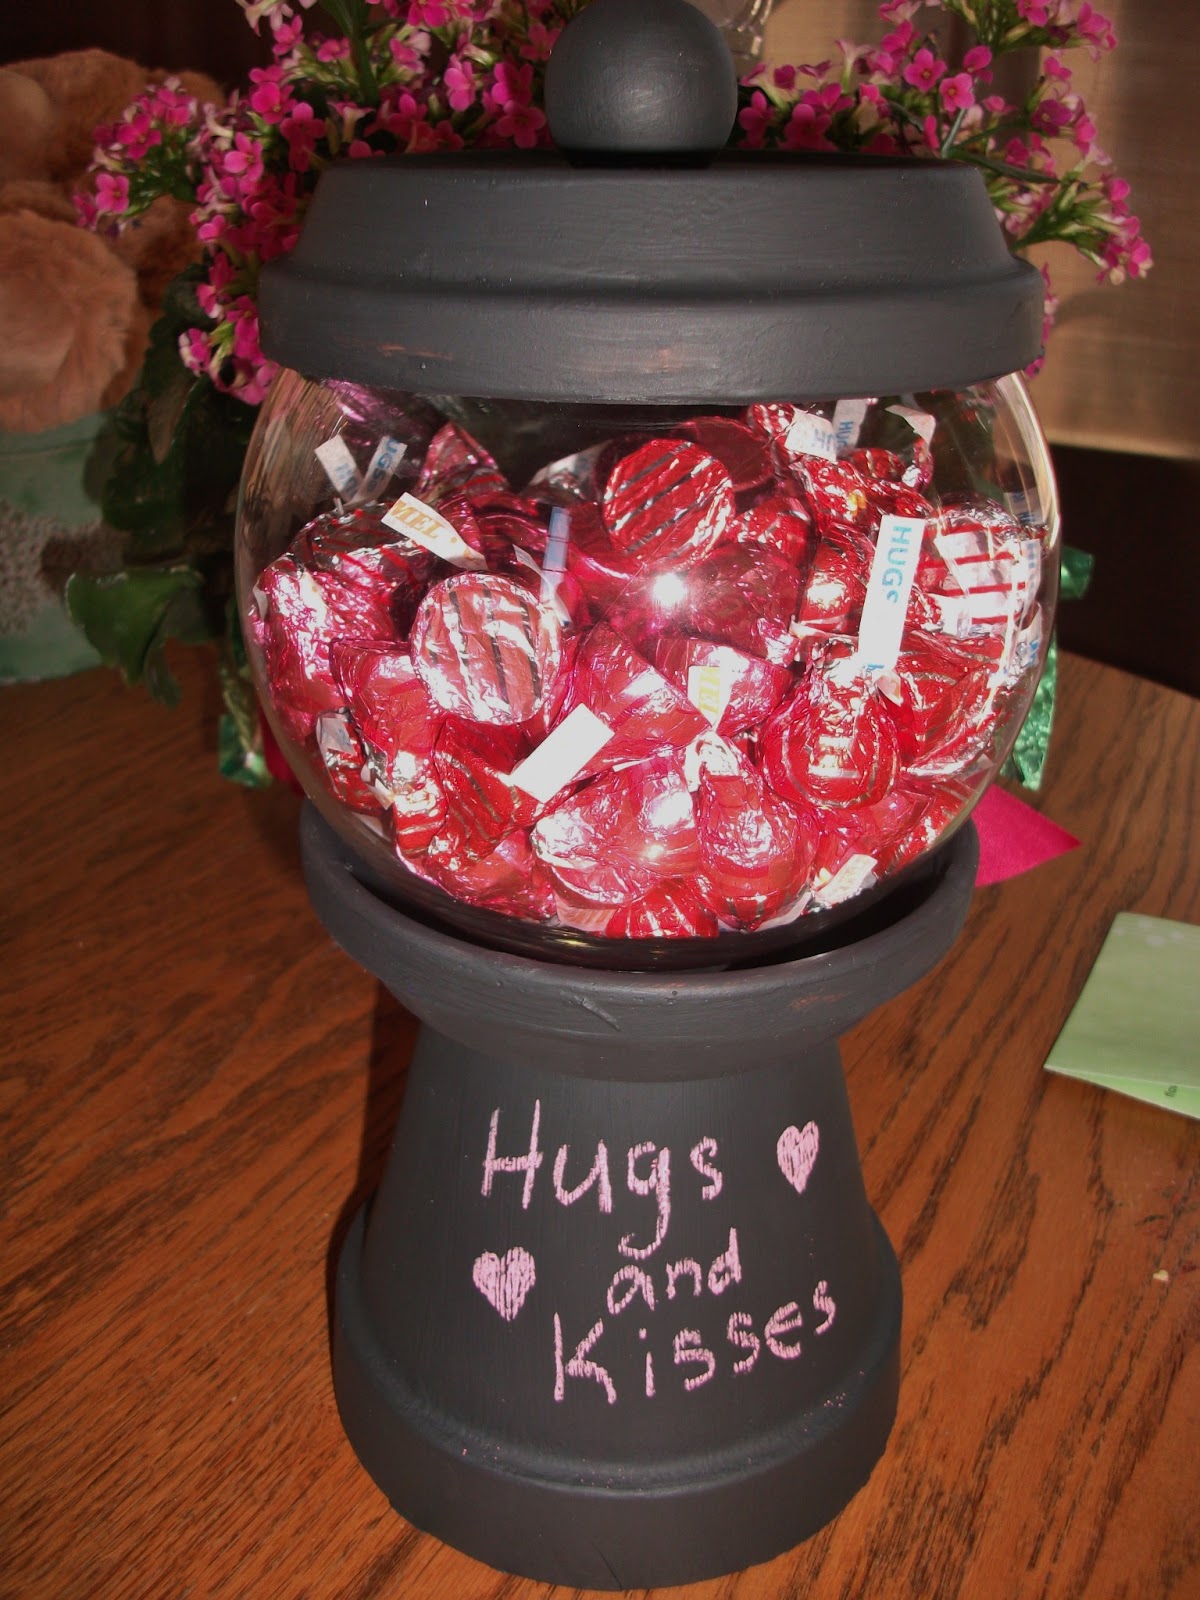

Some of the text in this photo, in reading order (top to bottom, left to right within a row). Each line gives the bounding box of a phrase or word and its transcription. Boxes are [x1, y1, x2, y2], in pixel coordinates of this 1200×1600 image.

[481, 1099, 723, 1260] Hugs
[607, 1226, 742, 1315] and
[553, 1279, 836, 1405] Kisses
